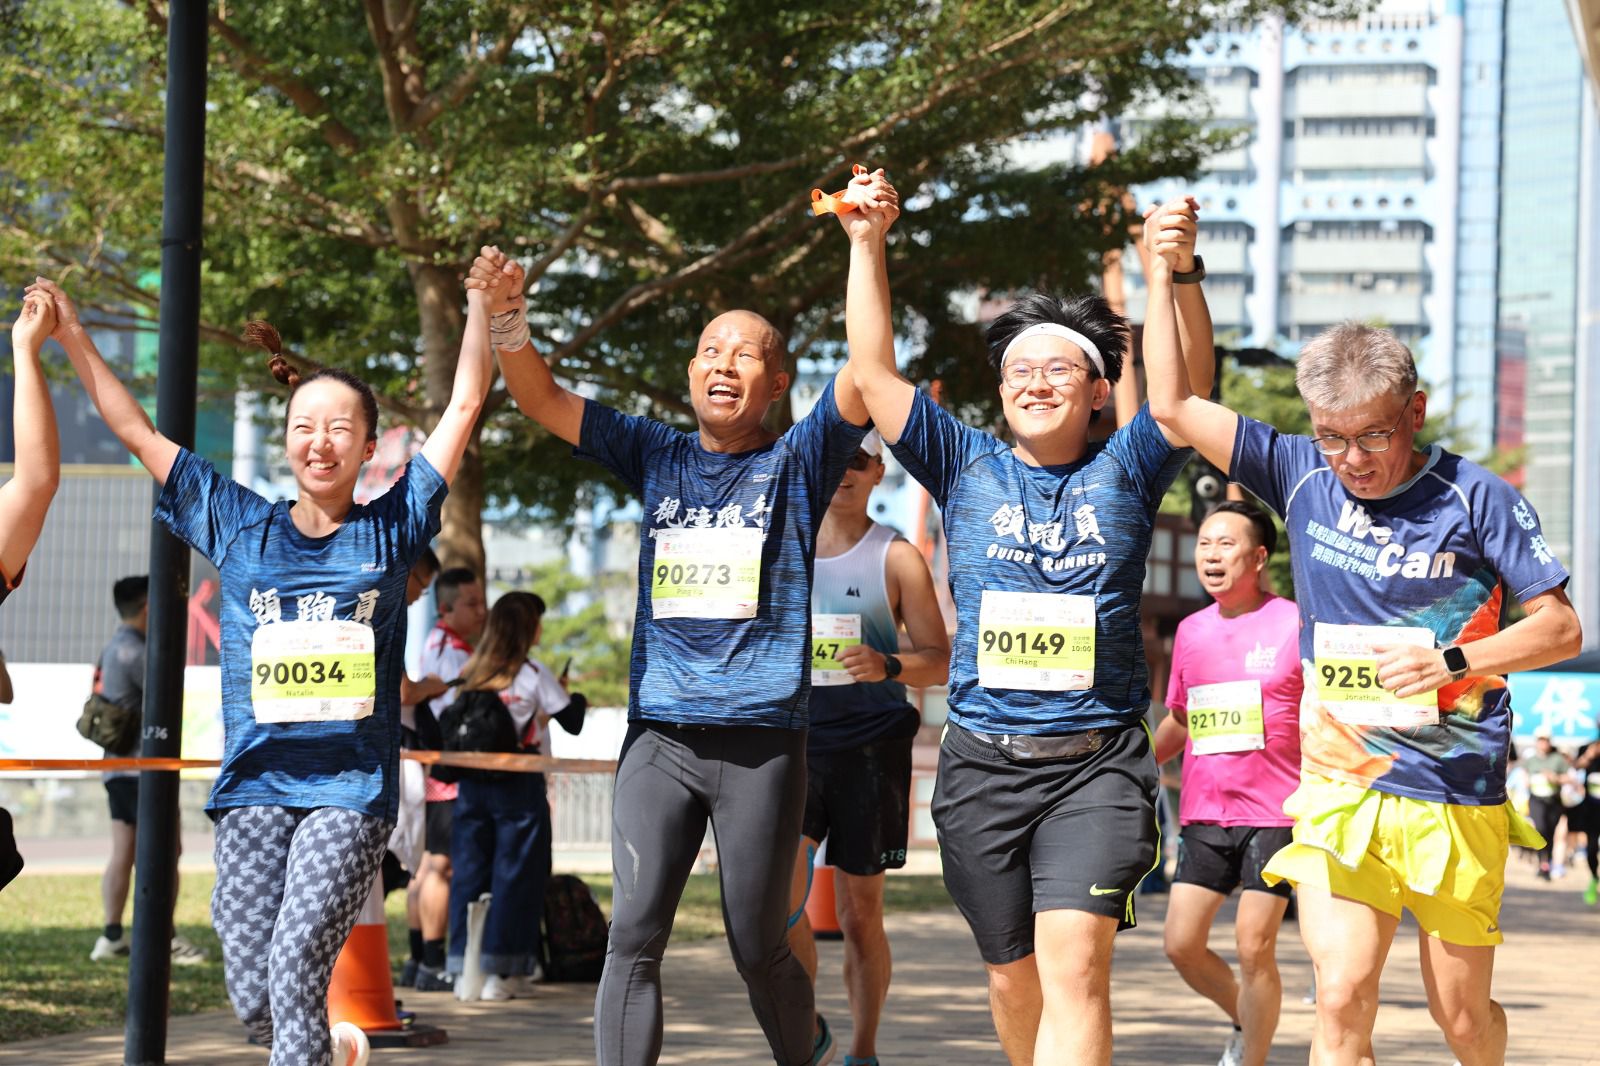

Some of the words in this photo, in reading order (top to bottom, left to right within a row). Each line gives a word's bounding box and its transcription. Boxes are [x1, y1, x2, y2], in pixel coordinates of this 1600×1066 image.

[988, 503, 1105, 551] 領跑員
[1336, 500, 1393, 545] We
[986, 543, 1034, 564] GUIDE
[1042, 552, 1107, 572] RUNNER
[1375, 542, 1456, 579] Can
[657, 564, 731, 586] 90273
[249, 588, 380, 627] 領跑員
[812, 643, 839, 660] 47
[983, 630, 1065, 655] 90149
[1072, 645, 1092, 653] 10:00
[256, 661, 346, 685] 90034
[1345, 693, 1381, 702] Jonathan
[1191, 711, 1241, 730] 92170
